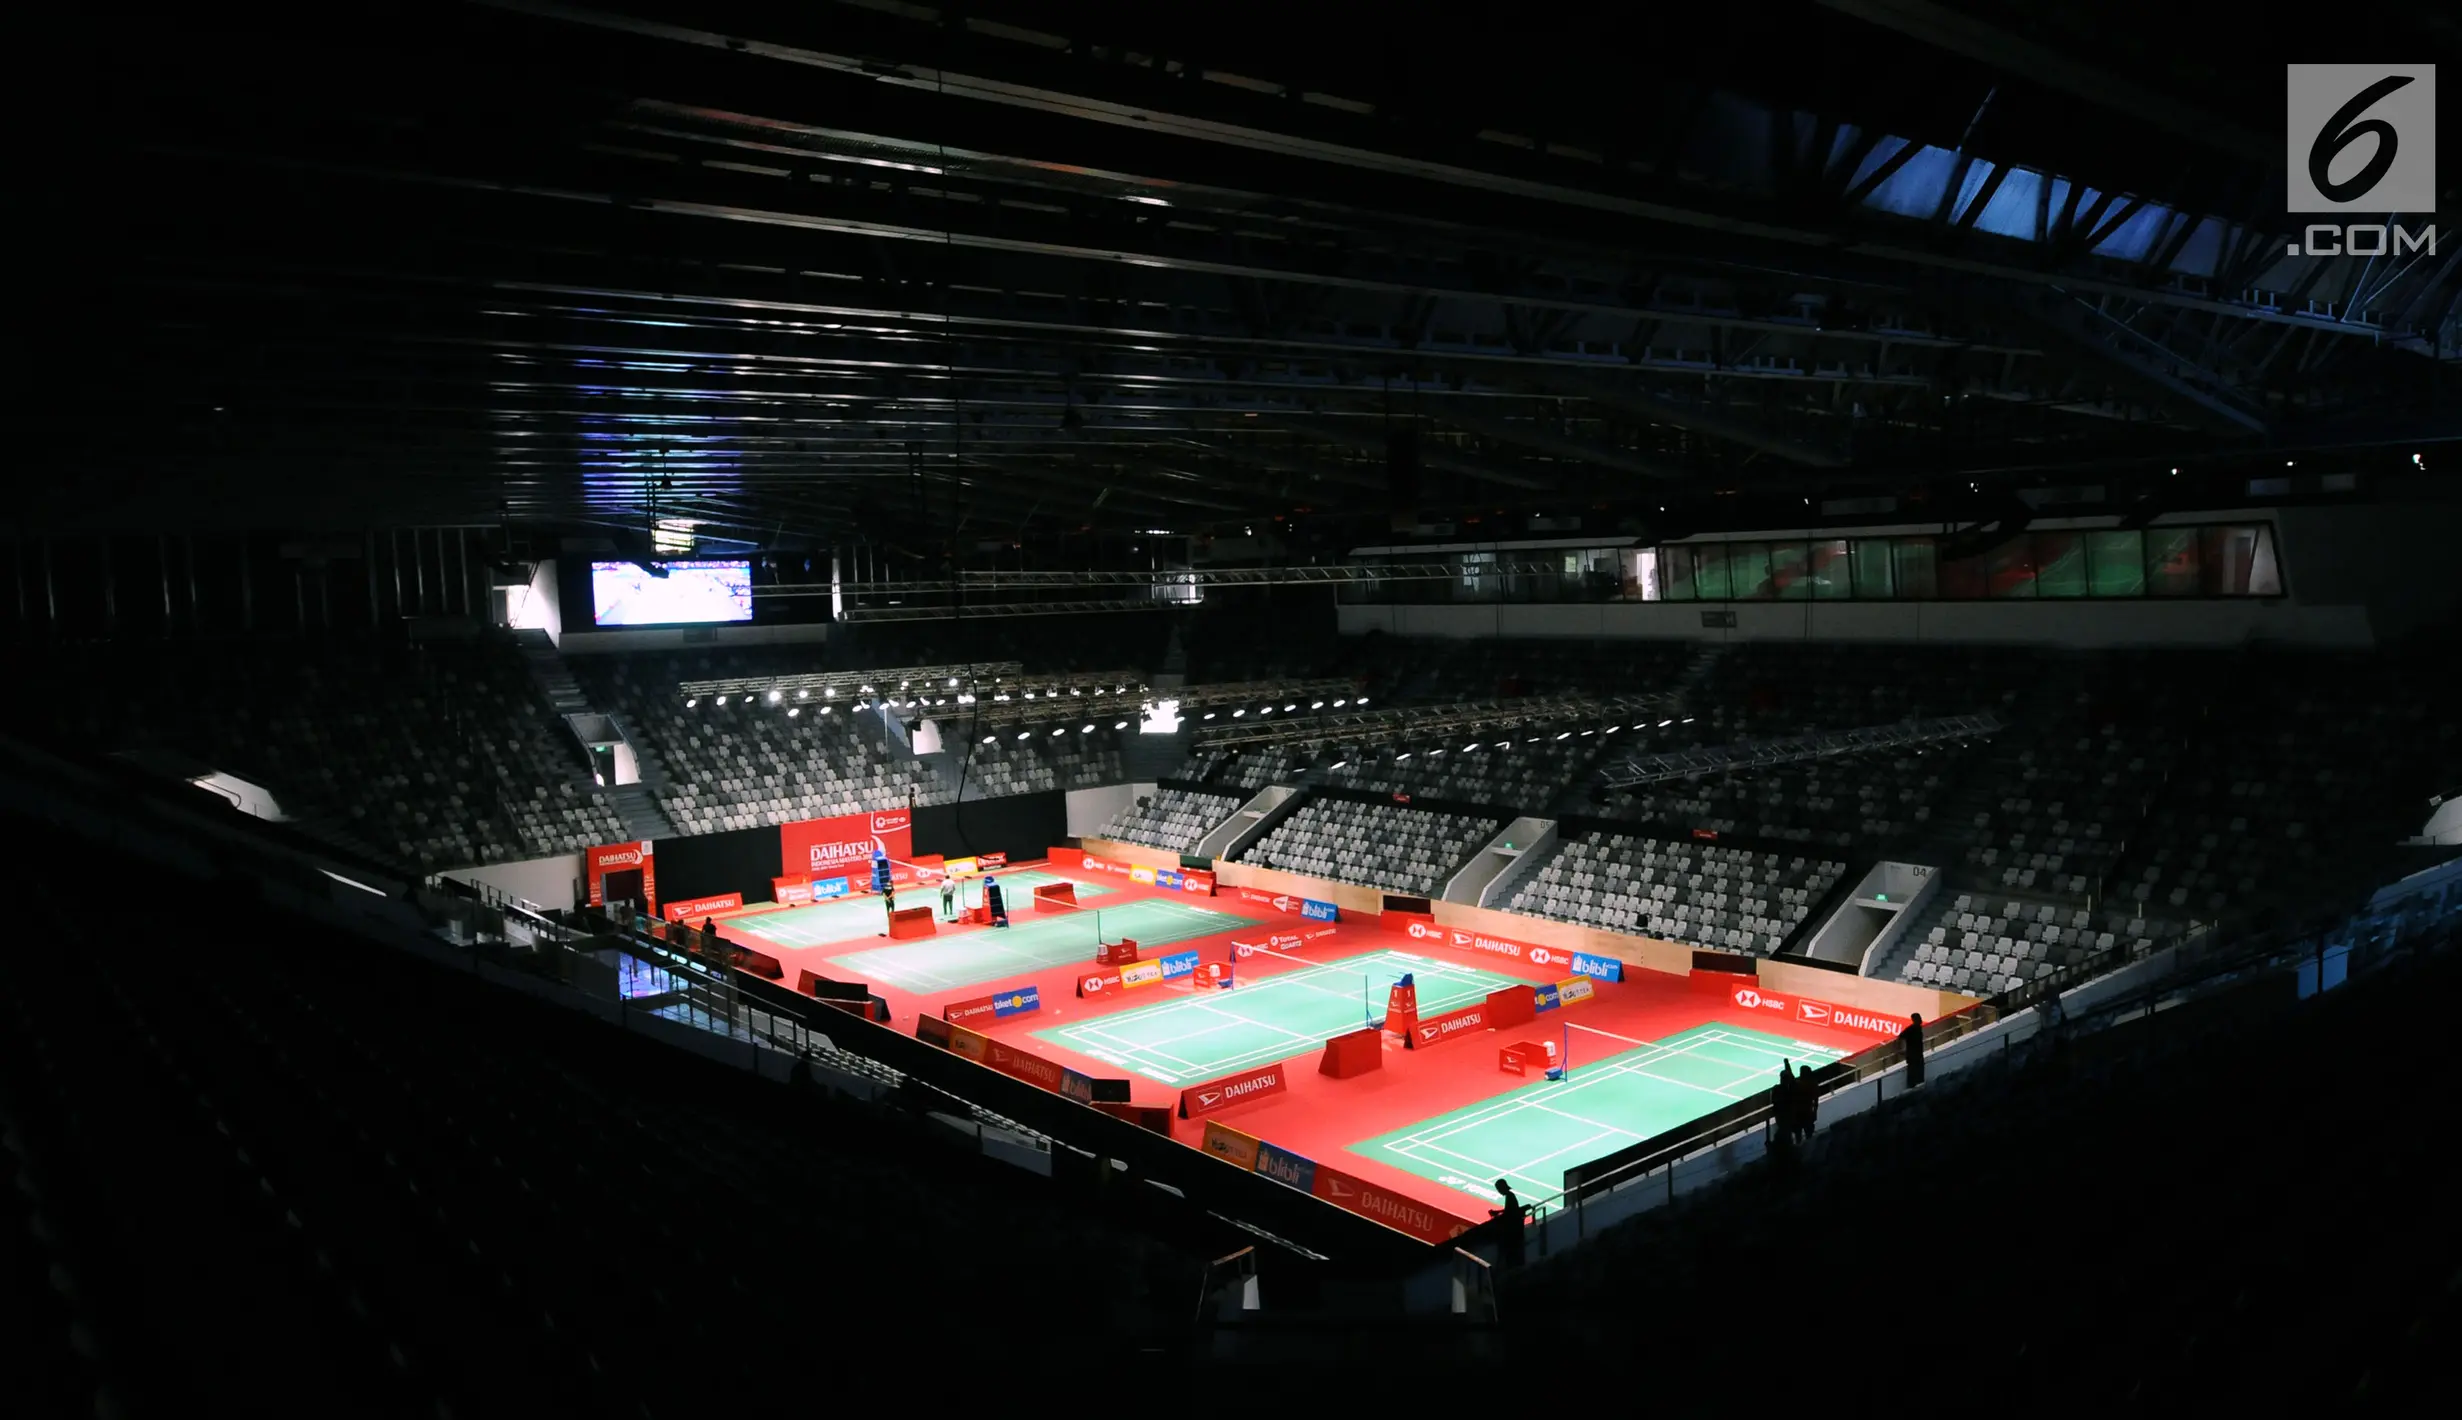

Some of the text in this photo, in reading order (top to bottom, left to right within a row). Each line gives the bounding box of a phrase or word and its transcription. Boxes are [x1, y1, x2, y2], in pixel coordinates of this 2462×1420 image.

[598, 850, 636, 863] DAIHATSU
[811, 840, 874, 861] DAIHATSU
[1912, 866, 1926, 877] 04
[694, 899, 735, 912] DAIHATSU
[1474, 937, 1521, 957] DAIHATSU
[1550, 954, 1569, 965] HSBC
[964, 1004, 994, 1016] DAIHATSU
[1762, 998, 1785, 1010] HSBC
[1441, 1013, 1481, 1033] DAIHATSU
[1834, 1010, 1902, 1036] DAIHATSU
[1013, 1056, 1056, 1083] DAIHATSU
[1224, 1074, 1276, 1098] DAIHATSU
[1361, 1191, 1434, 1232] DAIHATSU
